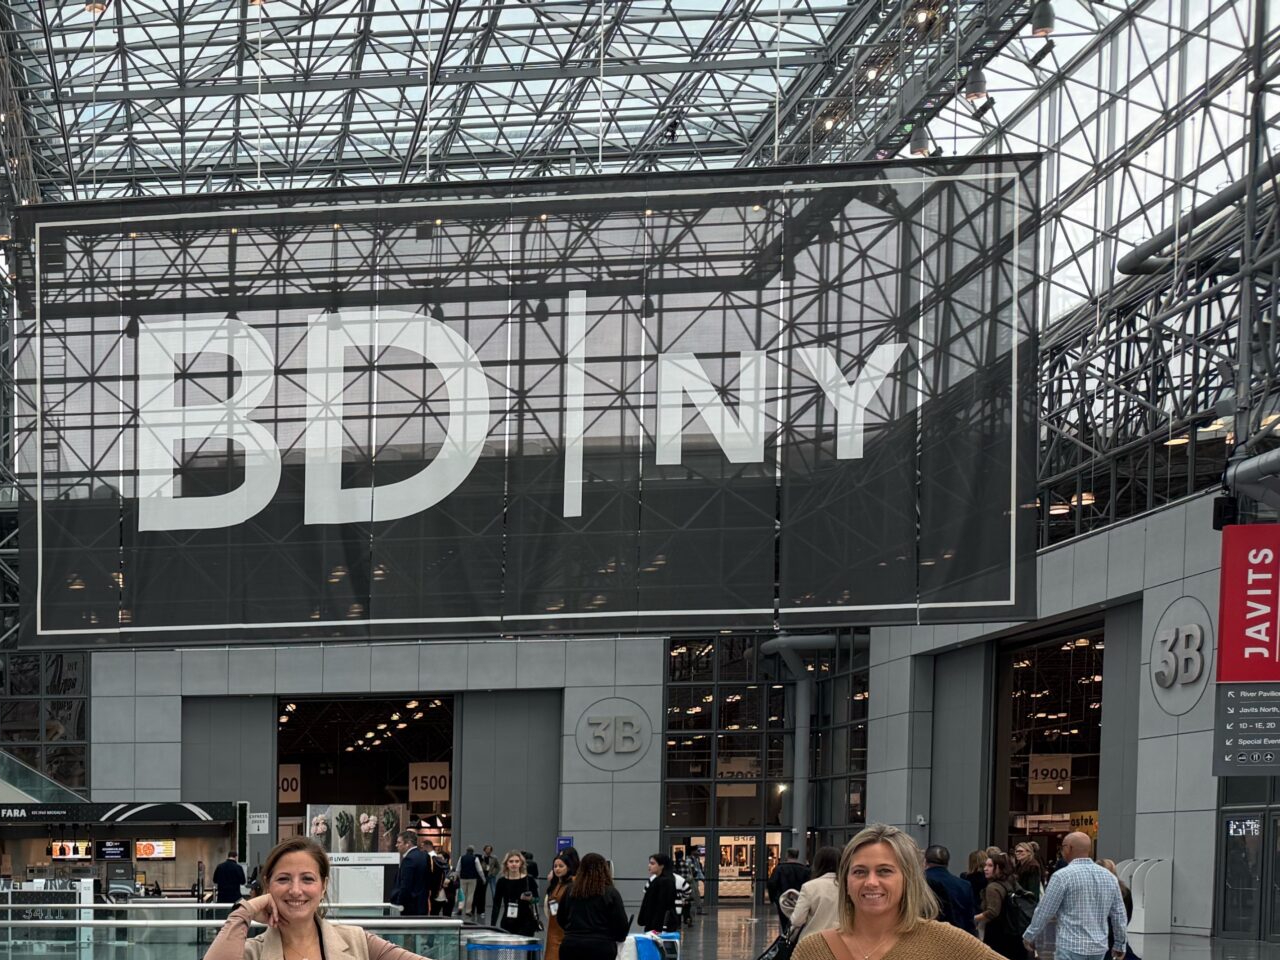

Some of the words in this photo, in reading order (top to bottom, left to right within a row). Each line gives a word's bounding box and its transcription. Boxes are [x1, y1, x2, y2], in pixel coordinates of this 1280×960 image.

[1244, 548, 1274, 658] JAVITS
[1154, 623, 1204, 688] 3B
[585, 715, 642, 755] 3B
[1238, 738, 1262, 746] Special
[1031, 768, 1069, 780] 1900
[279, 777, 299, 792] 00
[411, 775, 447, 791] 1500
[1, 808, 27, 818] FARA
[22, 907, 64, 920] 3411
